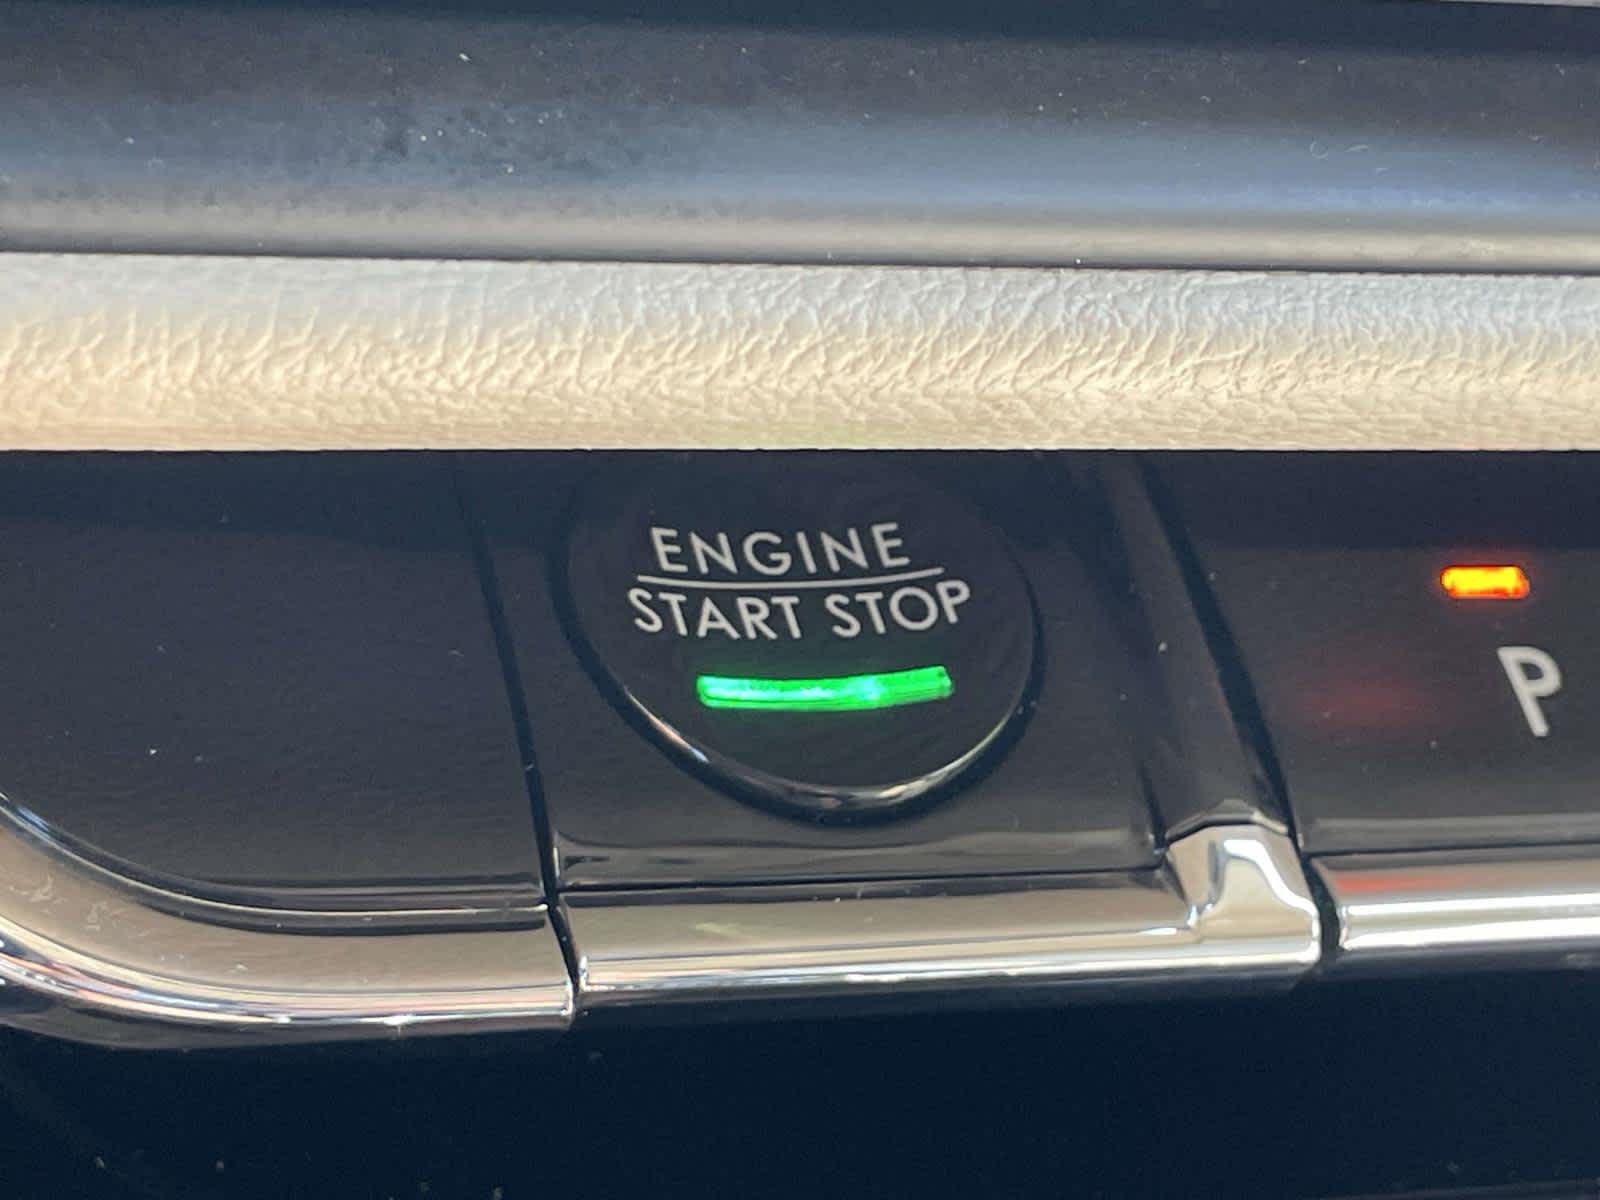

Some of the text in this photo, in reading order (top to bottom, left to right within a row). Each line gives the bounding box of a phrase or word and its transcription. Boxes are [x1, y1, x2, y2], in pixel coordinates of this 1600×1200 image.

[651, 522, 911, 576] ENGINE
[627, 579, 971, 640] START STOP
[1497, 646, 1562, 738] P
